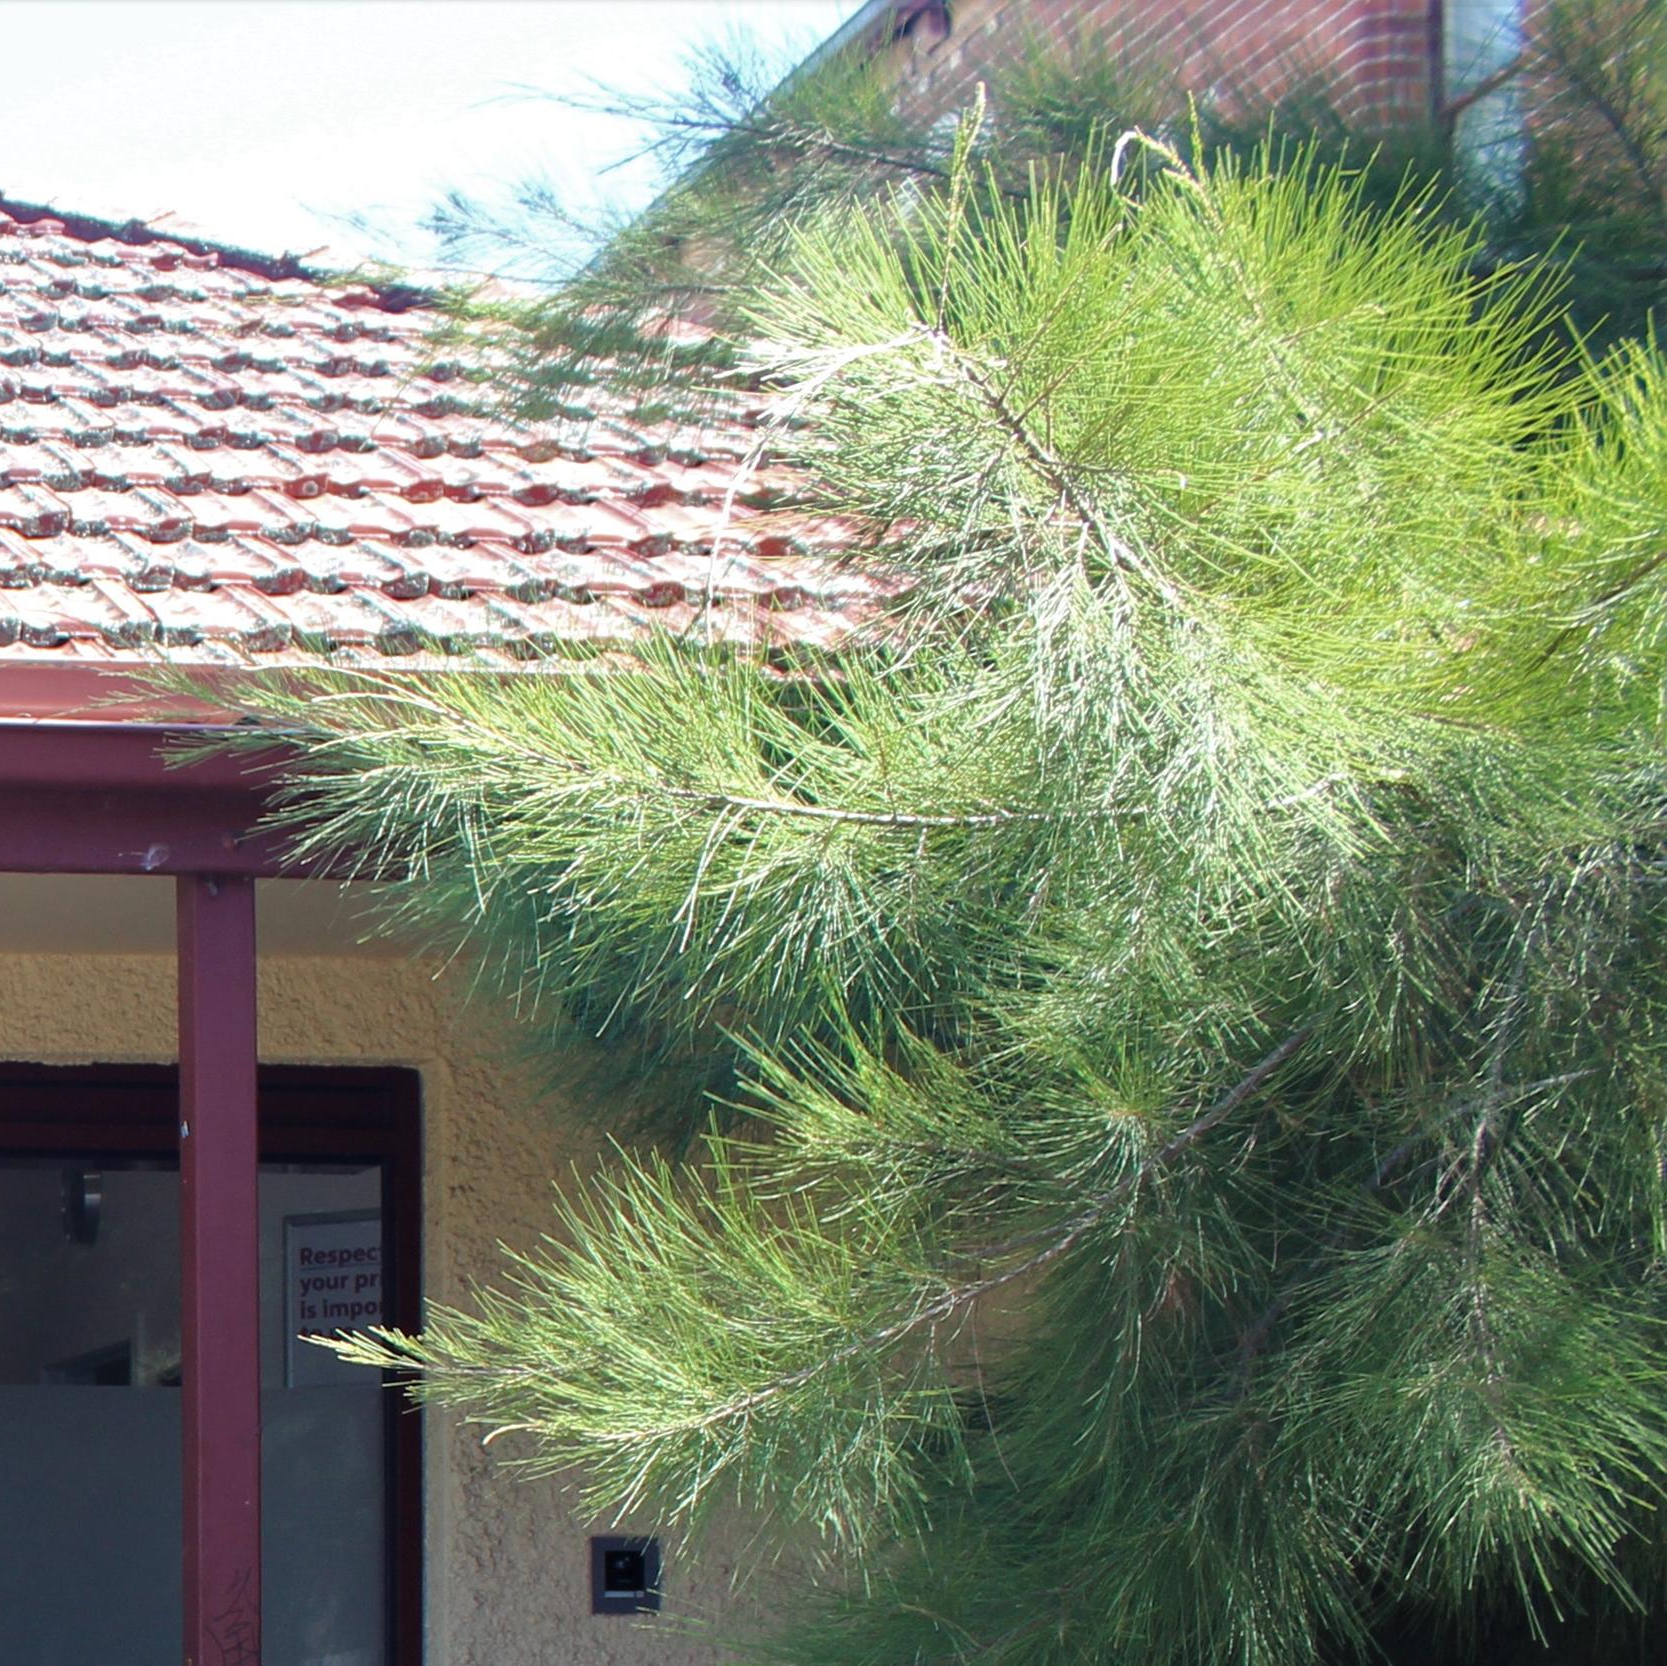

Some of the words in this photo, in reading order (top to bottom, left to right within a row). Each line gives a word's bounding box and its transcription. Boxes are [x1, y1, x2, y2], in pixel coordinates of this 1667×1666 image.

[299, 1246, 381, 1268] Respec
[299, 1275, 349, 1297] your
[355, 1272, 381, 1293] pr
[300, 1300, 317, 1319] is
